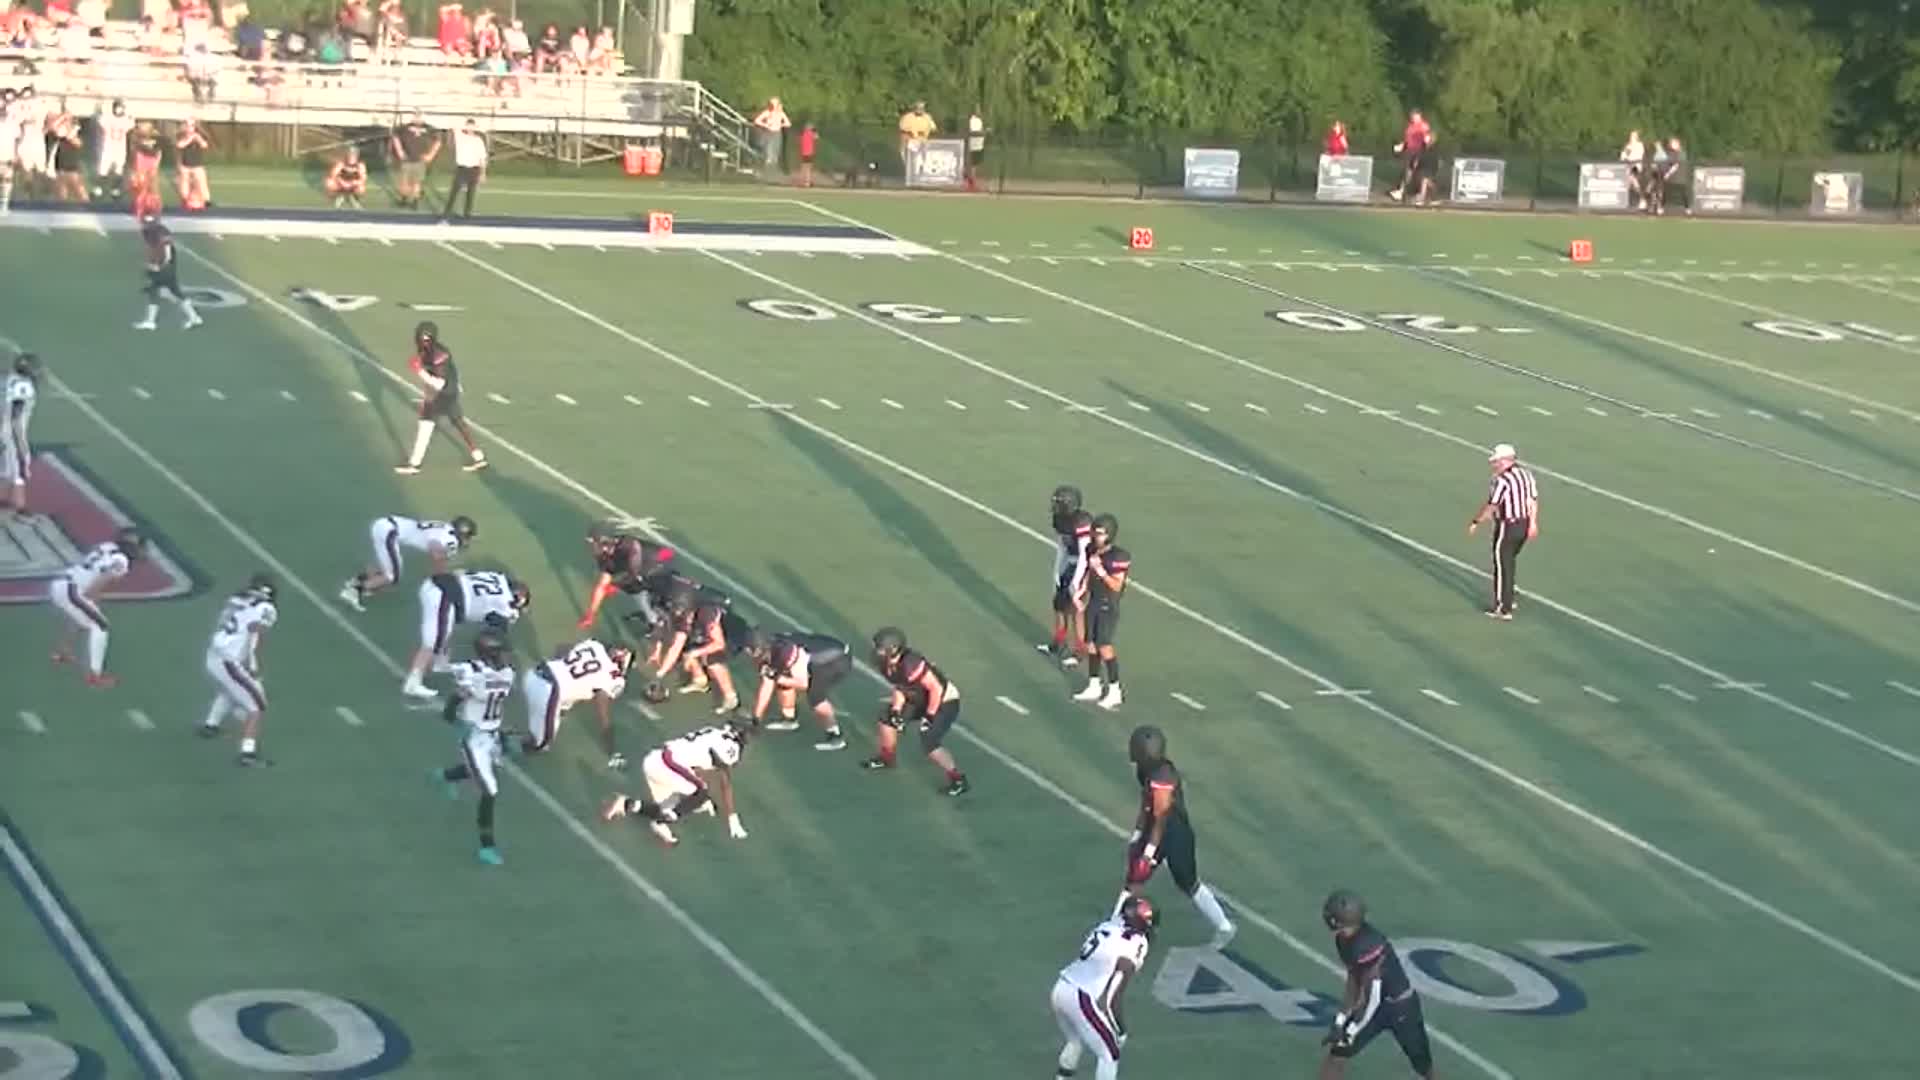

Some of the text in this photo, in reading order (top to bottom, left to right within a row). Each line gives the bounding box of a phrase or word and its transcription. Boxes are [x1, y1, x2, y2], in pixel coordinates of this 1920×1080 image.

[1135, 230, 1151, 245] 20
[471, 572, 504, 597] 72
[564, 647, 601, 680] 59
[1152, 937, 1562, 1024] 40
